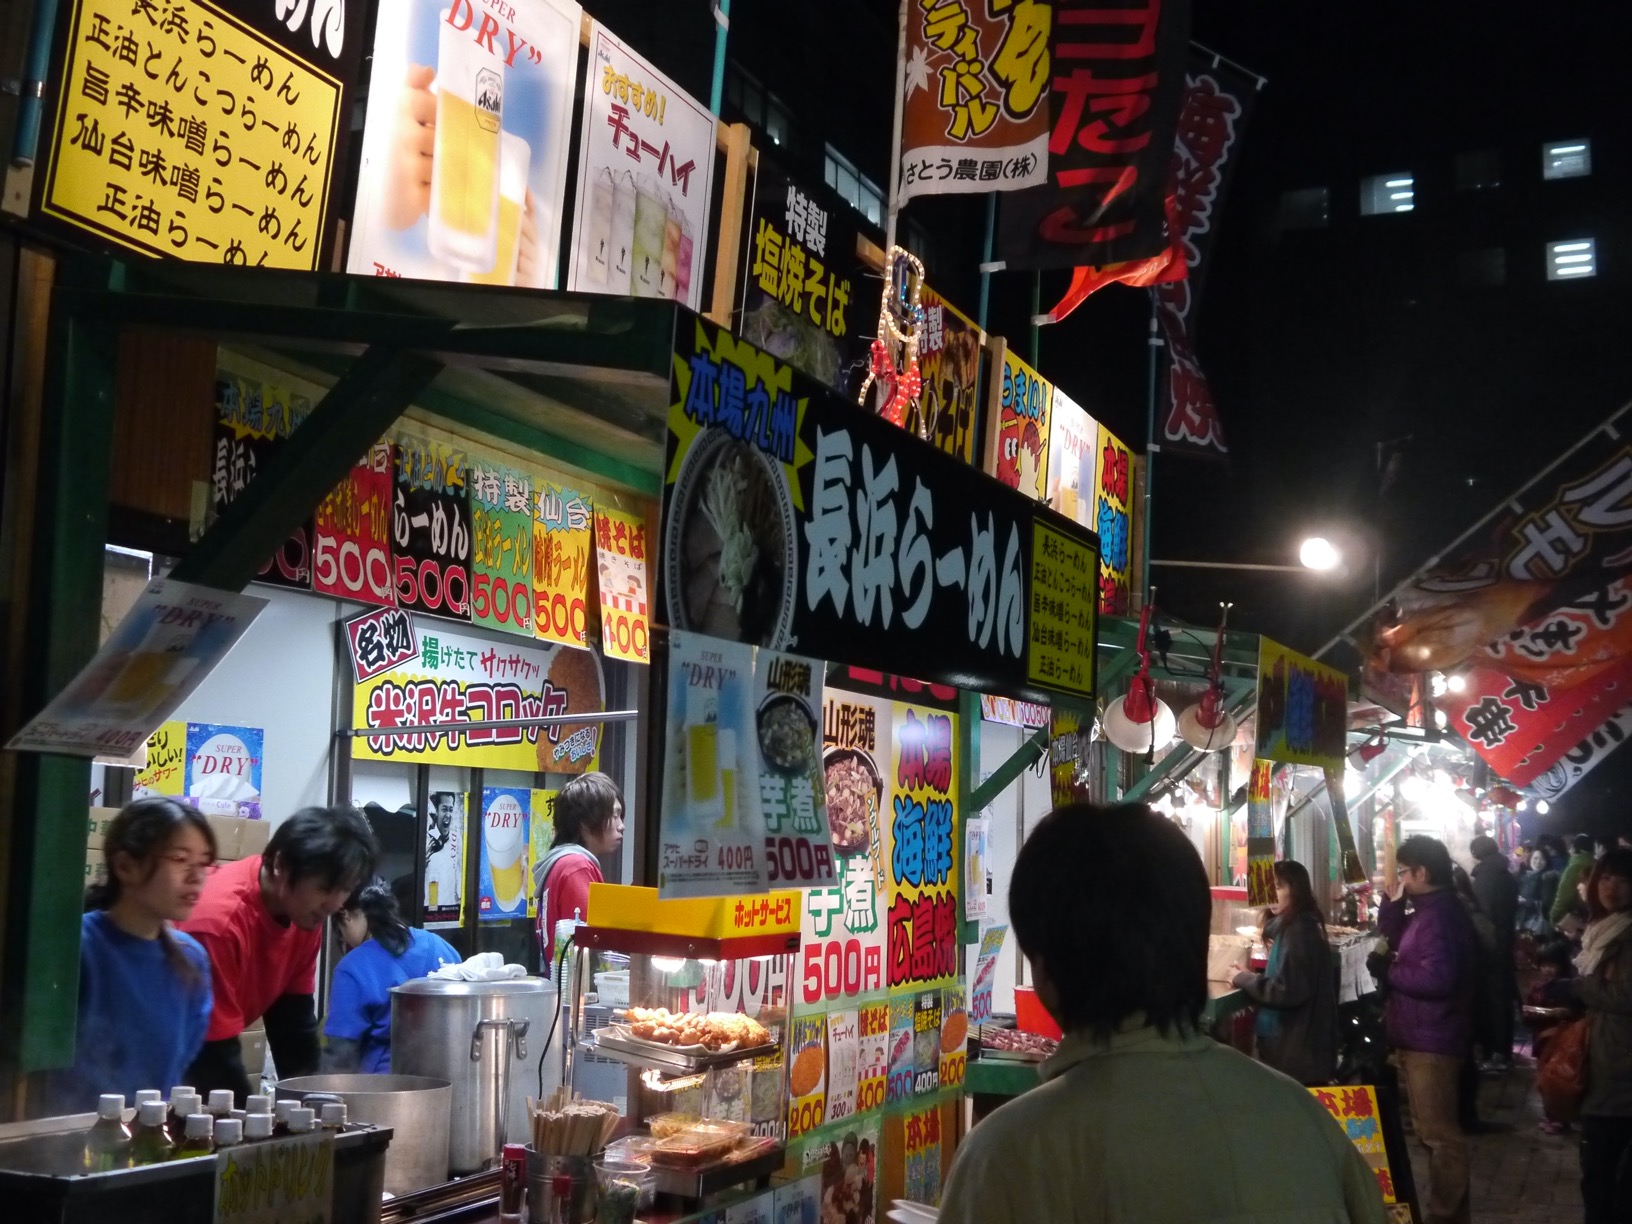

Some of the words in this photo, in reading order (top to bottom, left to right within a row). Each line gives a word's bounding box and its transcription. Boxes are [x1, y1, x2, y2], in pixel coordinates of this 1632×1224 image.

[85, 12, 321, 166] 正油とんこつらーめん
[919, 0, 999, 138] ティバル
[608, 102, 696, 198] チューハイ
[906, 152, 1037, 185] さとう農園(株)
[785, 185, 828, 258] 特製
[753, 217, 851, 337] 塩焼そば
[683, 352, 799, 465] 本場九州
[473, 463, 532, 517] 特製
[534, 489, 591, 531] 仙台
[394, 487, 469, 561] らーめん
[473, 507, 531, 578] 正油ラーメン
[595, 512, 646, 560] 焼そば
[804, 424, 1025, 660] 長浜らーめん
[357, 611, 412, 670] 名物
[422, 635, 478, 671] 揚げたて
[480, 647, 540, 679] サクサクッ
[701, 651, 722, 664] SUPER
[215, 744, 242, 754] SUPER
[367, 680, 568, 755] 米沢牛コロッケ
[823, 700, 876, 751] 山形魂
[900, 709, 953, 795] 本場
[499, 802, 517, 811] SUPER
[664, 854, 708, 869] スーパードライ
[718, 845, 754, 870] 400円
[765, 837, 832, 883] 500円
[867, 792, 886, 891] ソウルフード
[893, 793, 954, 888] 海鮮
[734, 898, 791, 930] ホットサービス
[887, 889, 957, 987] 広島焼
[803, 939, 881, 1004] 500円
[915, 1071, 938, 1093] 400円
